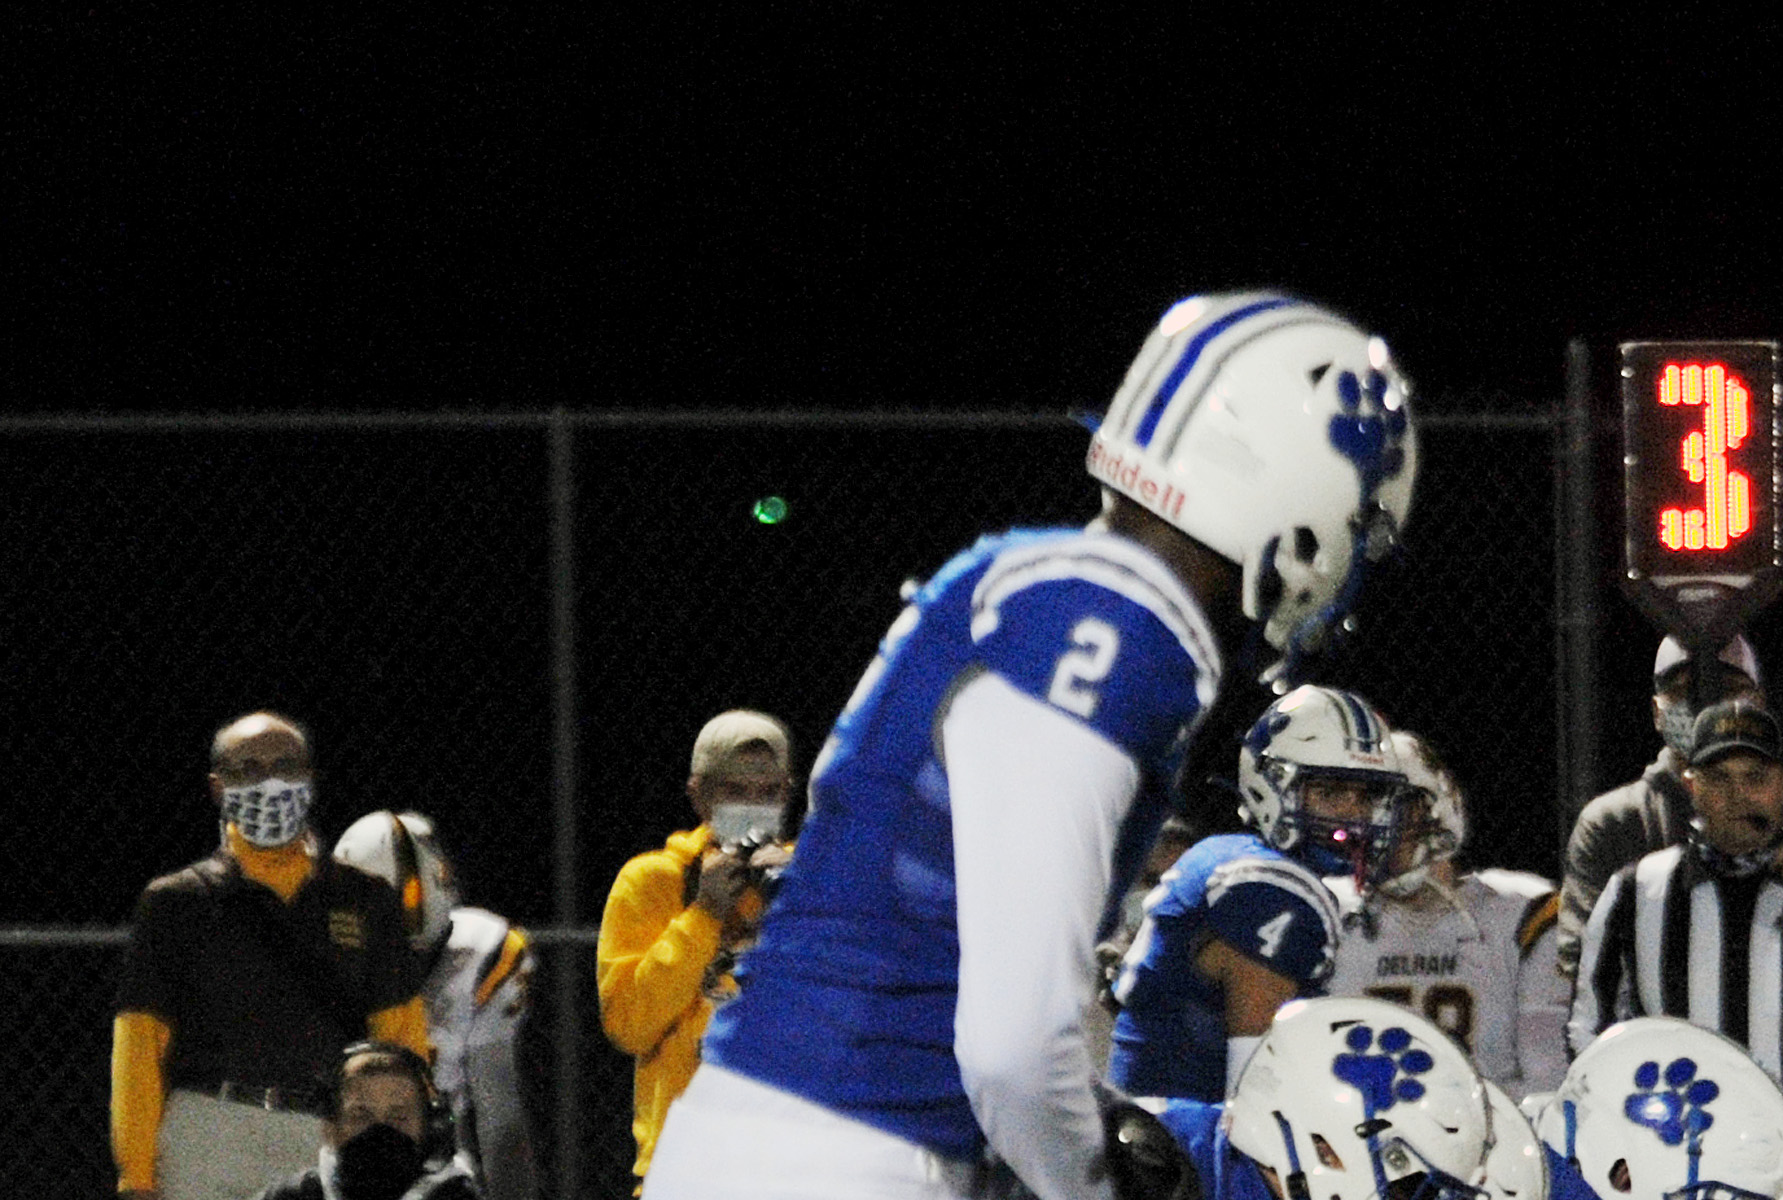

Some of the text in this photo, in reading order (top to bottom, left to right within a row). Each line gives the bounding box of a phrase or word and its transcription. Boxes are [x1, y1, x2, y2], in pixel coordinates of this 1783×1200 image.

[1659, 361, 1750, 551] 3
[1047, 615, 1120, 719] 2
[1257, 911, 1293, 959] 4
